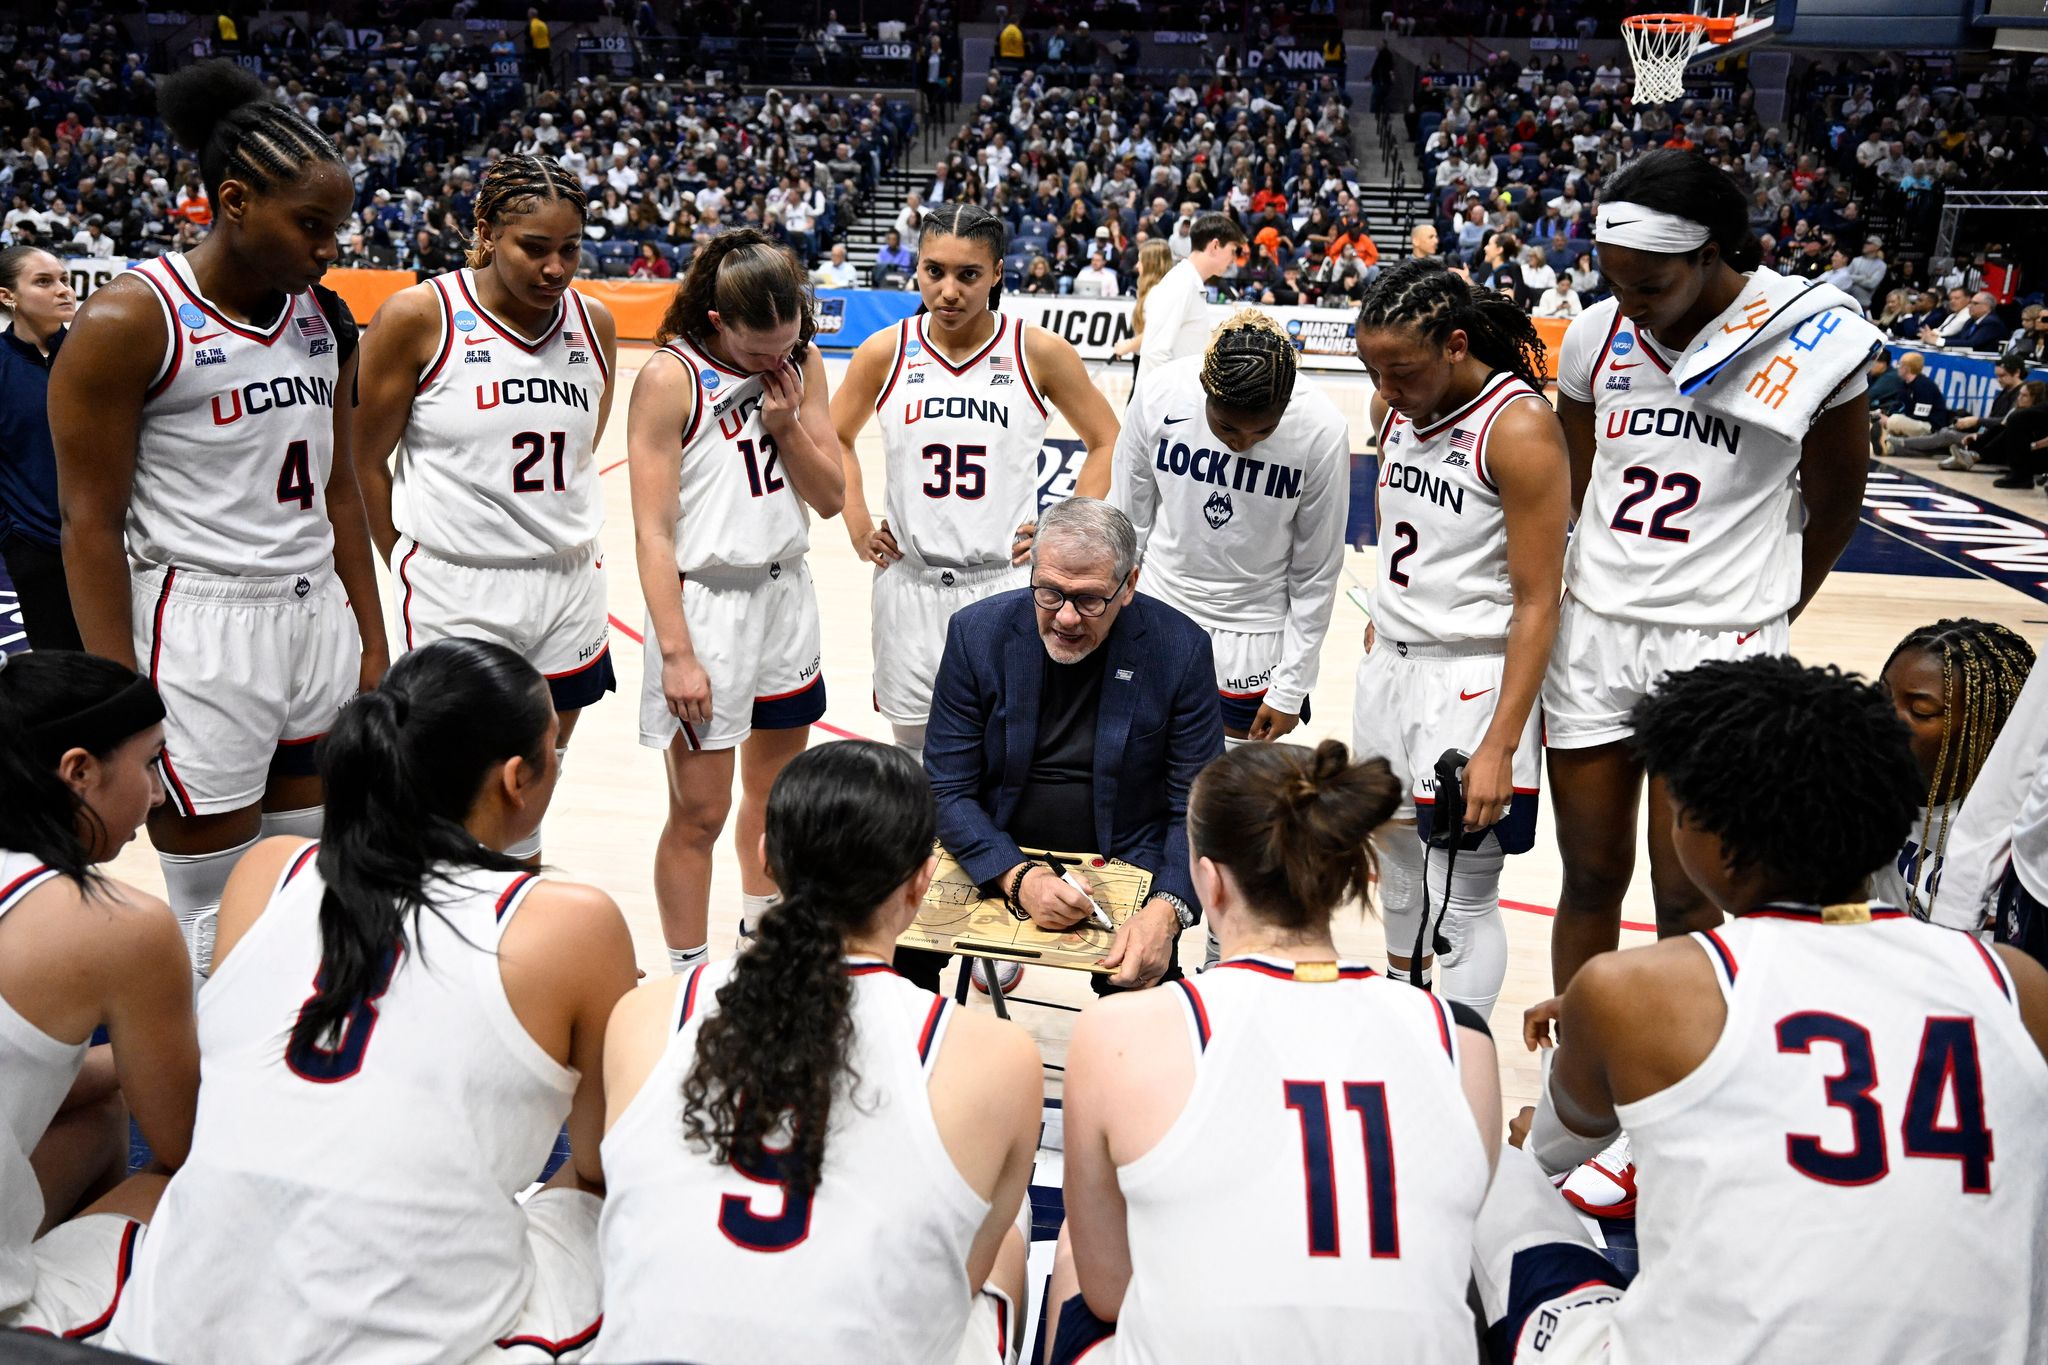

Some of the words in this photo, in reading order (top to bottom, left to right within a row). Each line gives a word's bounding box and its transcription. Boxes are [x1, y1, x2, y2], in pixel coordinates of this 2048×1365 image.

[599, 37, 626, 50] 109
[882, 43, 912, 58] 109
[495, 61, 519, 74] 108
[1248, 49, 1326, 70] DNKIN
[1847, 84, 1873, 98] 12
[456, 319, 476, 327] NCAA
[1041, 310, 1135, 348] UCON
[1300, 322, 1348, 337] MARCH
[196, 350, 207, 358] BE
[209, 348, 224, 357] THE
[309, 344, 334, 354] EAST
[311, 338, 328, 347] BIG
[1303, 336, 1358, 353] MADNES
[1613, 342, 1632, 350] NCAA
[195, 355, 226, 367] CHANGE
[464, 356, 491, 364] CHANGE
[1605, 382, 1631, 391] CHANGE
[1618, 376, 1631, 384] THE
[212, 376, 333, 426] UCONN
[476, 377, 589, 412] UCONN
[905, 397, 1008, 428] UCONN
[1606, 407, 1741, 455] UCONN
[512, 431, 566, 493] 21
[736, 433, 784, 498] 12
[1445, 456, 1470, 467] EAST
[1449, 450, 1467, 460] BIG
[277, 440, 314, 510] 4
[922, 444, 987, 500] 35
[1156, 438, 1231, 487] LOCK
[1232, 456, 1264, 495] IT
[1379, 462, 1464, 514] UCONN
[1610, 466, 1702, 543] 22
[1389, 521, 1418, 588] 2
[285, 922, 404, 1084] 8
[1775, 1010, 1994, 1194] 34
[718, 1082, 826, 1252] 9
[1282, 1078, 1401, 1259] 11
